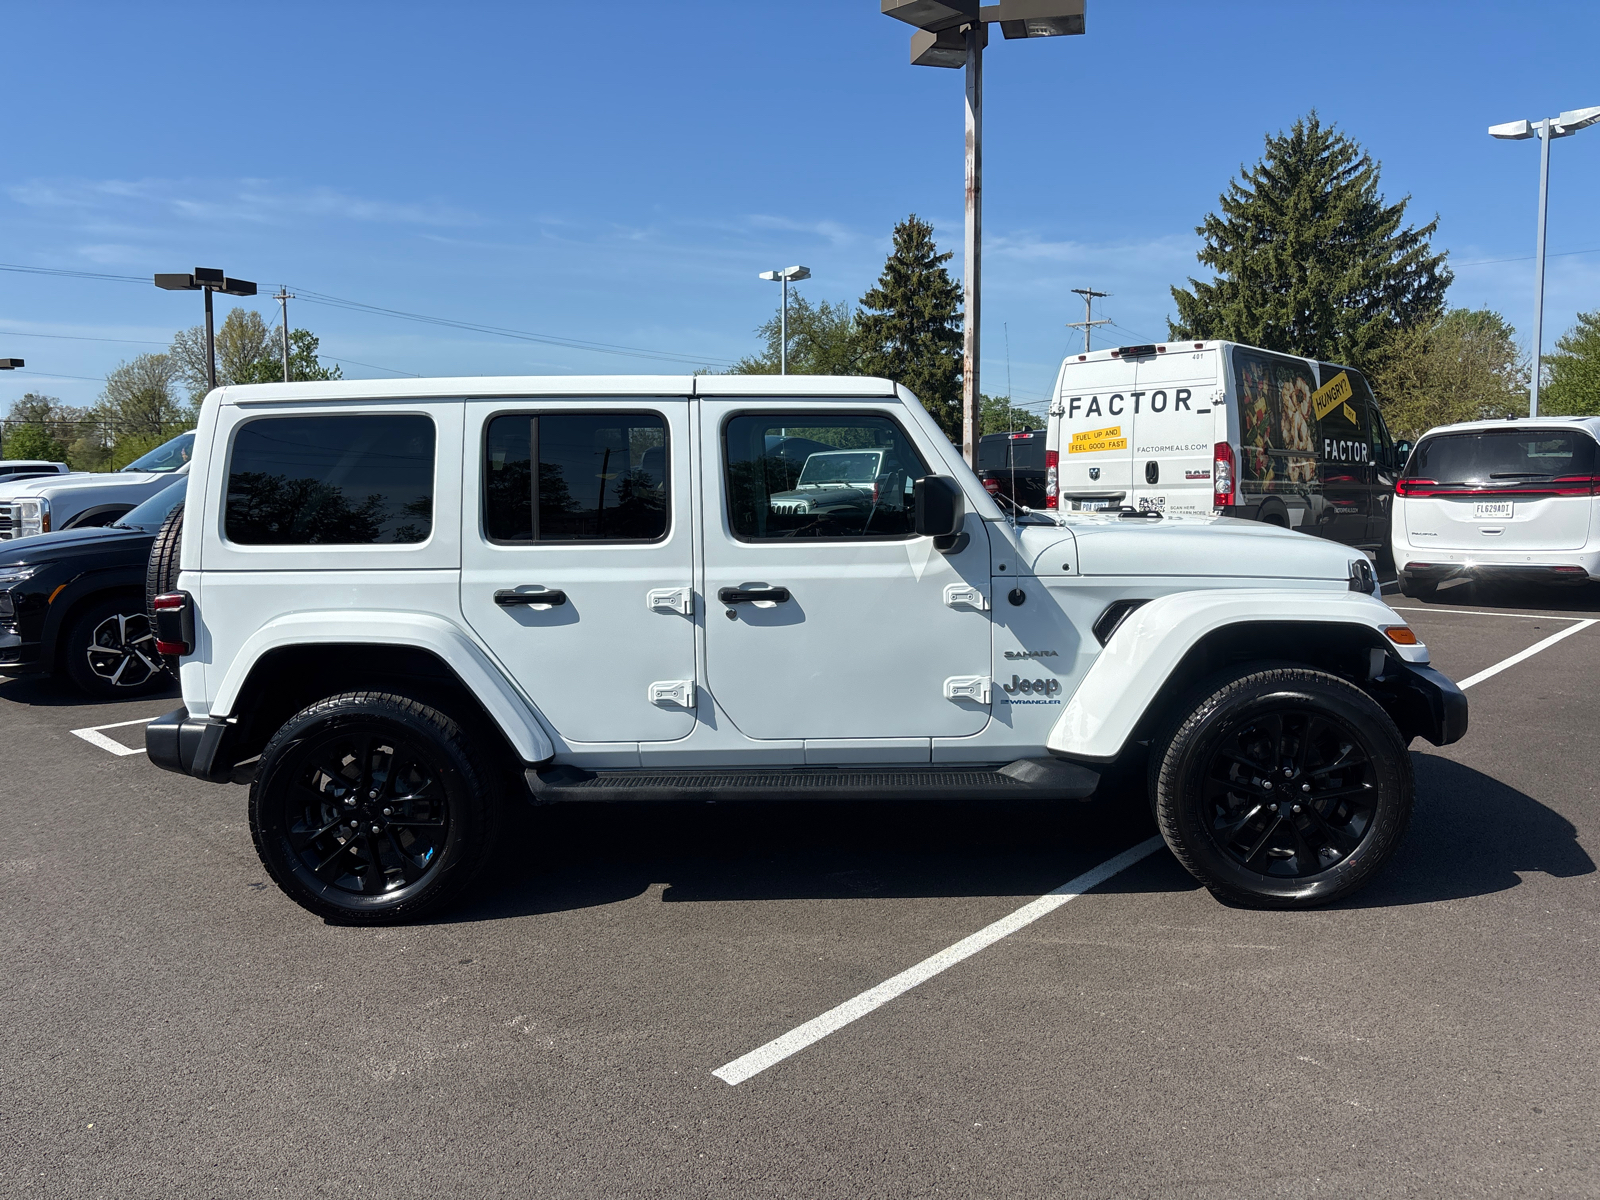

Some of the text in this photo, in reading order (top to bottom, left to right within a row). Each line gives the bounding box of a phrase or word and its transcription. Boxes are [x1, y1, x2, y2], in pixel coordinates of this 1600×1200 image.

[1316, 378, 1347, 411] HUNGRY?
[1089, 442, 1105, 450] GOOD
[1137, 444, 1207, 452] FACTORMEALS.COM
[1325, 439, 1367, 462] FACTOR
[1004, 650, 1058, 658] SAHARA
[1003, 675, 1058, 695] Jeep
